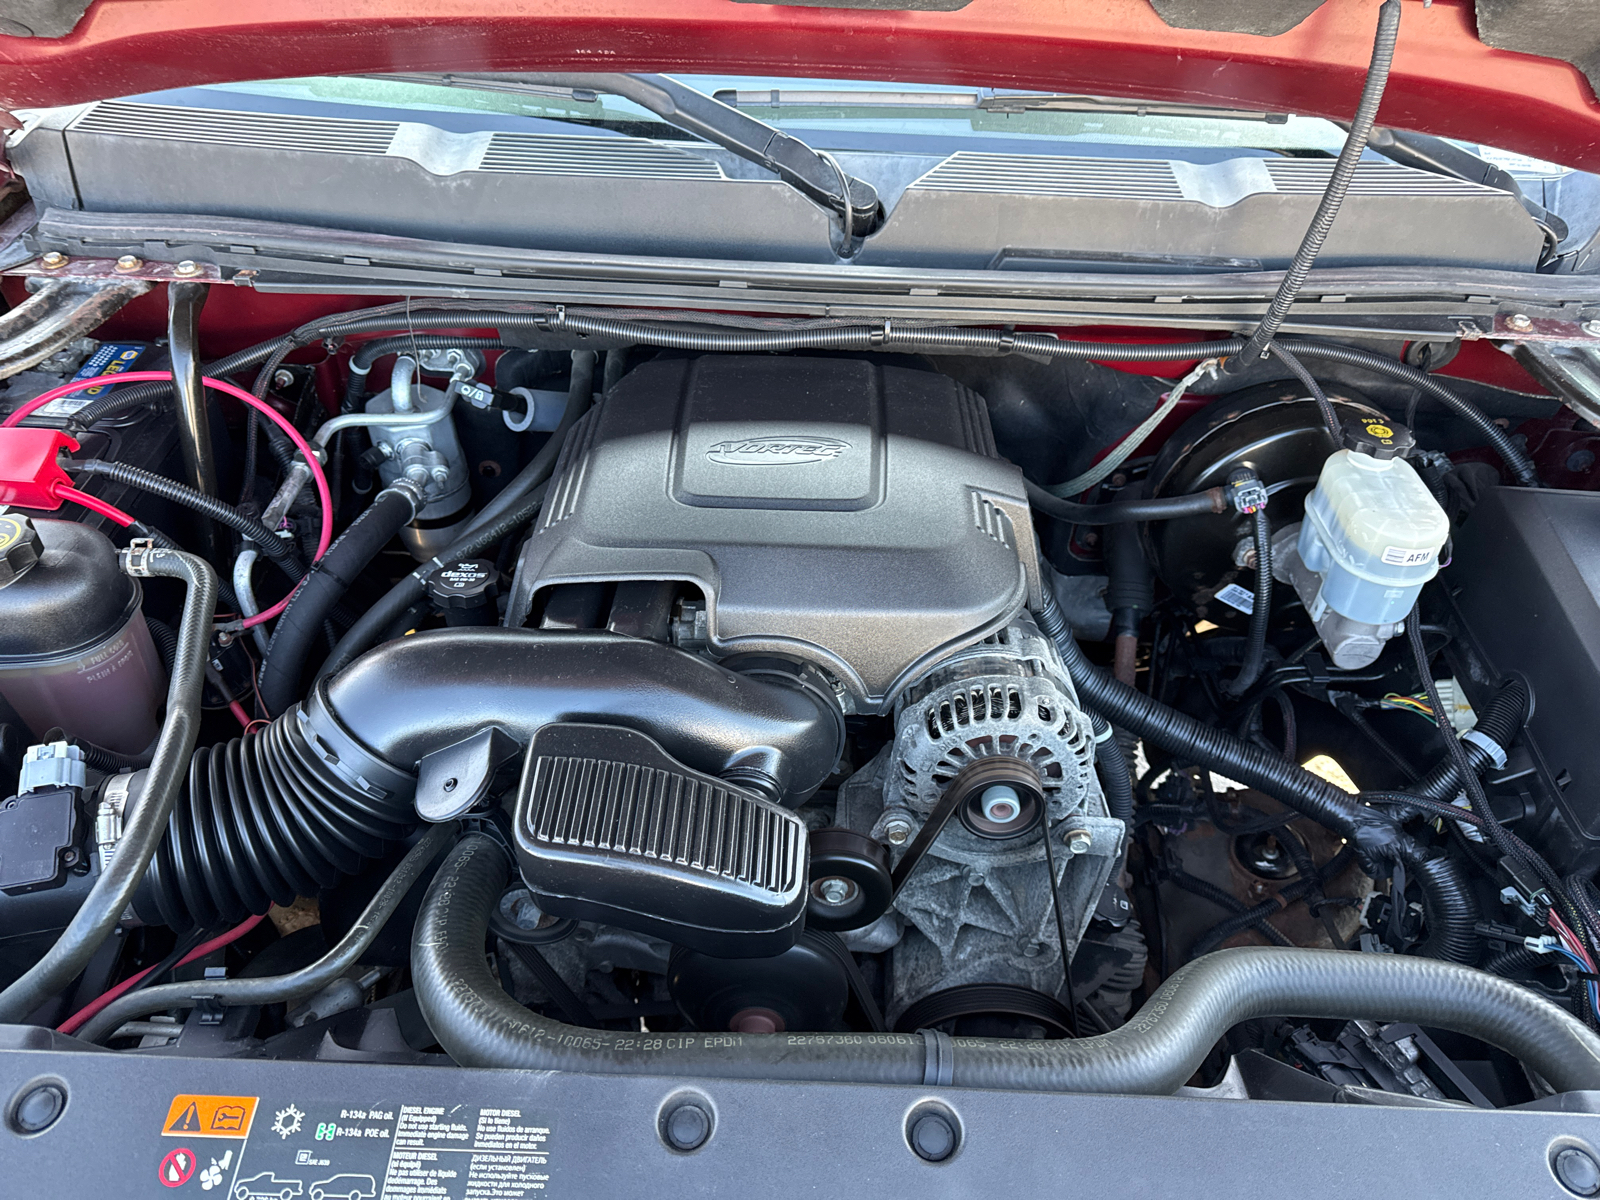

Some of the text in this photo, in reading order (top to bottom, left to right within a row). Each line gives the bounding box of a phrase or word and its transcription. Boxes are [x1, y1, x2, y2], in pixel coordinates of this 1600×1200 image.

[718, 443, 842, 456] VORTEC
[1407, 552, 1429, 563] AFM
[91, 652, 108, 664] FULL
[615, 1038, 662, 1050] 22:28
[666, 1038, 694, 1050] CIP
[788, 1036, 862, 1045] 22767360
[340, 1109, 367, 1119] R-134a
[369, 1111, 383, 1119] PAG
[336, 1127, 362, 1137] R-134a
[364, 1128, 379, 1138] POE
[446, 1132, 469, 1140] damage
[418, 1152, 438, 1160] DIESEL
[512, 1155, 547, 1164] ДВИГАТЕЛЬ
[488, 1164, 526, 1172] установлен)
